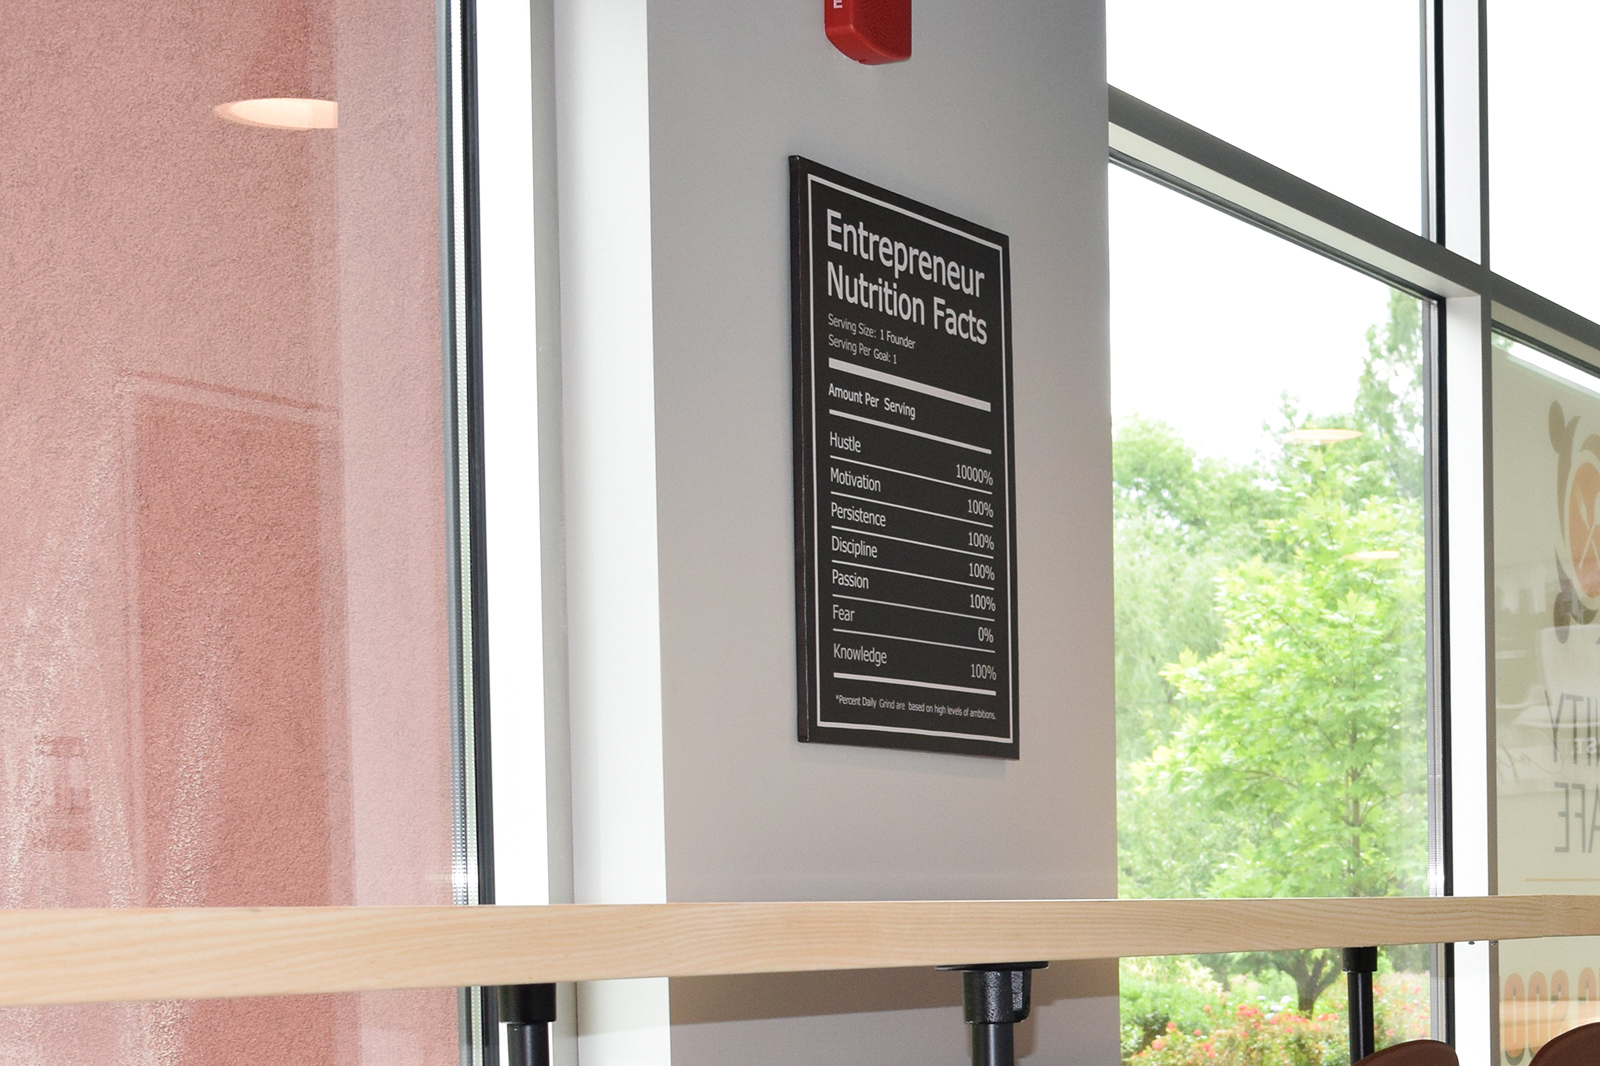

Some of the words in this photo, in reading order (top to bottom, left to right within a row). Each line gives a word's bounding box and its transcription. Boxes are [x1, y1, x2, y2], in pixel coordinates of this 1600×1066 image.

[826, 208, 985, 298] Entrepreneur
[827, 261, 925, 326] Nutrition
[933, 296, 988, 345] Facts
[827, 313, 857, 336] Serving
[858, 322, 877, 339] Size:
[880, 329, 885, 341] 1
[886, 330, 916, 350] Founder
[828, 333, 858, 356] Serving
[858, 342, 872, 357] Per
[873, 348, 891, 363] Goal:
[893, 354, 898, 365] 1
[828, 382, 863, 404] Amount
[864, 392, 879, 408] Per
[883, 397, 916, 421] Serving
[829, 431, 861, 453] Hustle
[830, 467, 882, 493] Motivation
[955, 463, 994, 486] 10000%
[830, 502, 887, 528] Persistence
[967, 499, 994, 518] 100%
[831, 535, 878, 558] Discipline
[967, 531, 995, 551] 100%
[832, 569, 869, 590] Passion
[968, 562, 995, 581] 100%
[832, 604, 855, 622] Fear
[969, 594, 996, 612] 100%
[977, 627, 994, 643] 0%
[833, 643, 888, 667] Knowledge
[970, 663, 997, 681] 100%
[861, 696, 877, 709] Daily
[878, 698, 895, 710] Grind
[895, 701, 906, 711] are
[907, 701, 925, 713] based
[925, 705, 934, 713] on
[933, 703, 946, 717] high
